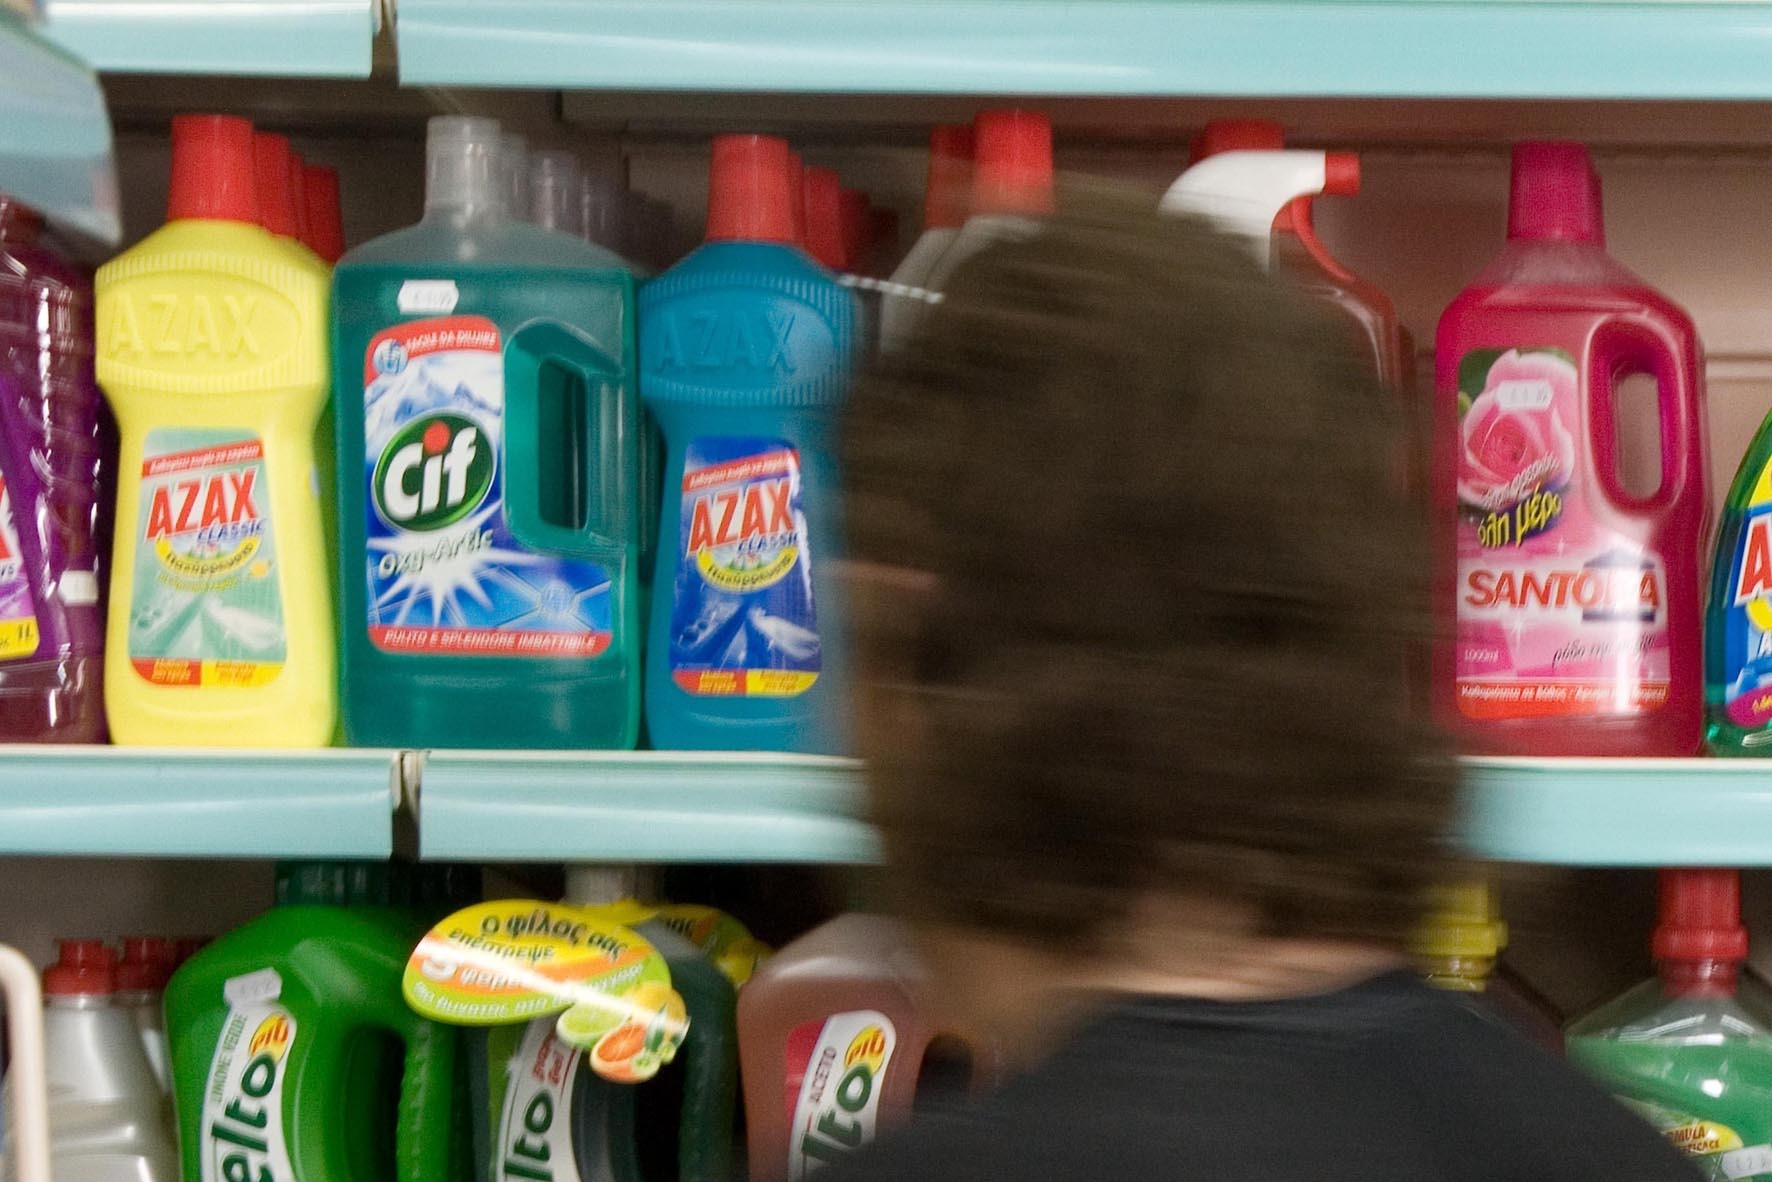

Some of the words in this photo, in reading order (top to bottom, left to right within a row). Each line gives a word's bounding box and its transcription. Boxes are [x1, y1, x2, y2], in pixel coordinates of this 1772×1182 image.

[108, 292, 262, 360] AZAX
[656, 309, 797, 374] AZAX
[146, 468, 259, 540] AZAX
[382, 420, 477, 522] Cif
[687, 480, 796, 553] AZAX
[506, 909, 587, 946] φίλος
